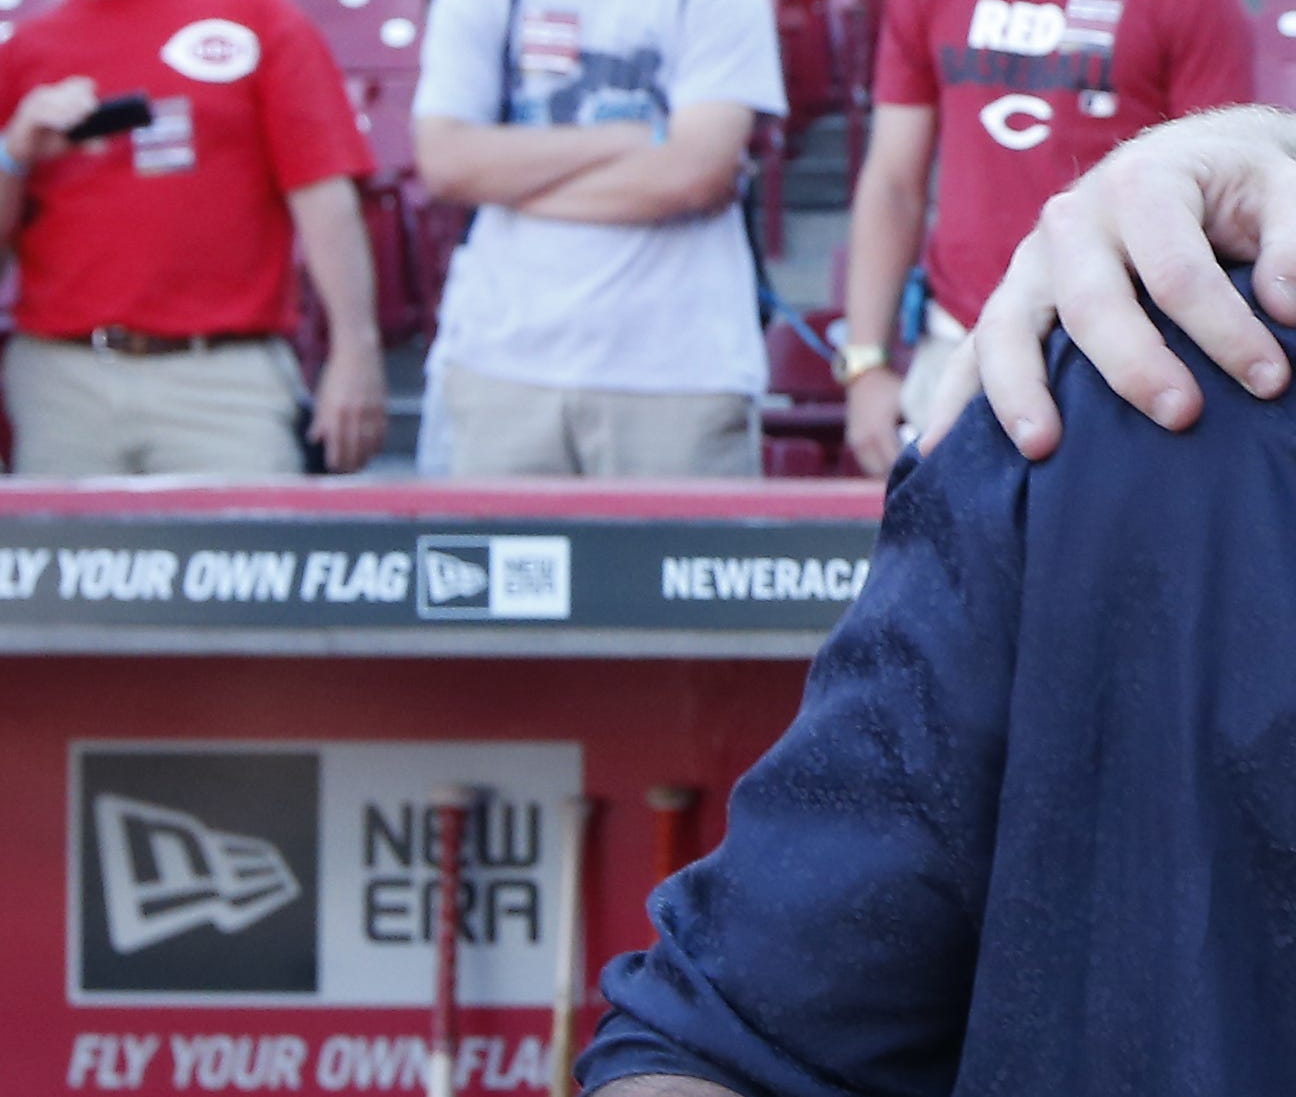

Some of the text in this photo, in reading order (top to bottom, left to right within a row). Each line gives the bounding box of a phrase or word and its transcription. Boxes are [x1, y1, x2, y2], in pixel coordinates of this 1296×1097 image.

[980, 93, 1053, 150] C
[57, 548, 178, 601] YOUR
[182, 550, 296, 602] OWN
[300, 551, 411, 603] FLAG
[364, 801, 538, 868] NEW
[364, 878, 539, 944] ERA
[67, 1033, 555, 1091] FLY YOUR OWN FLA
